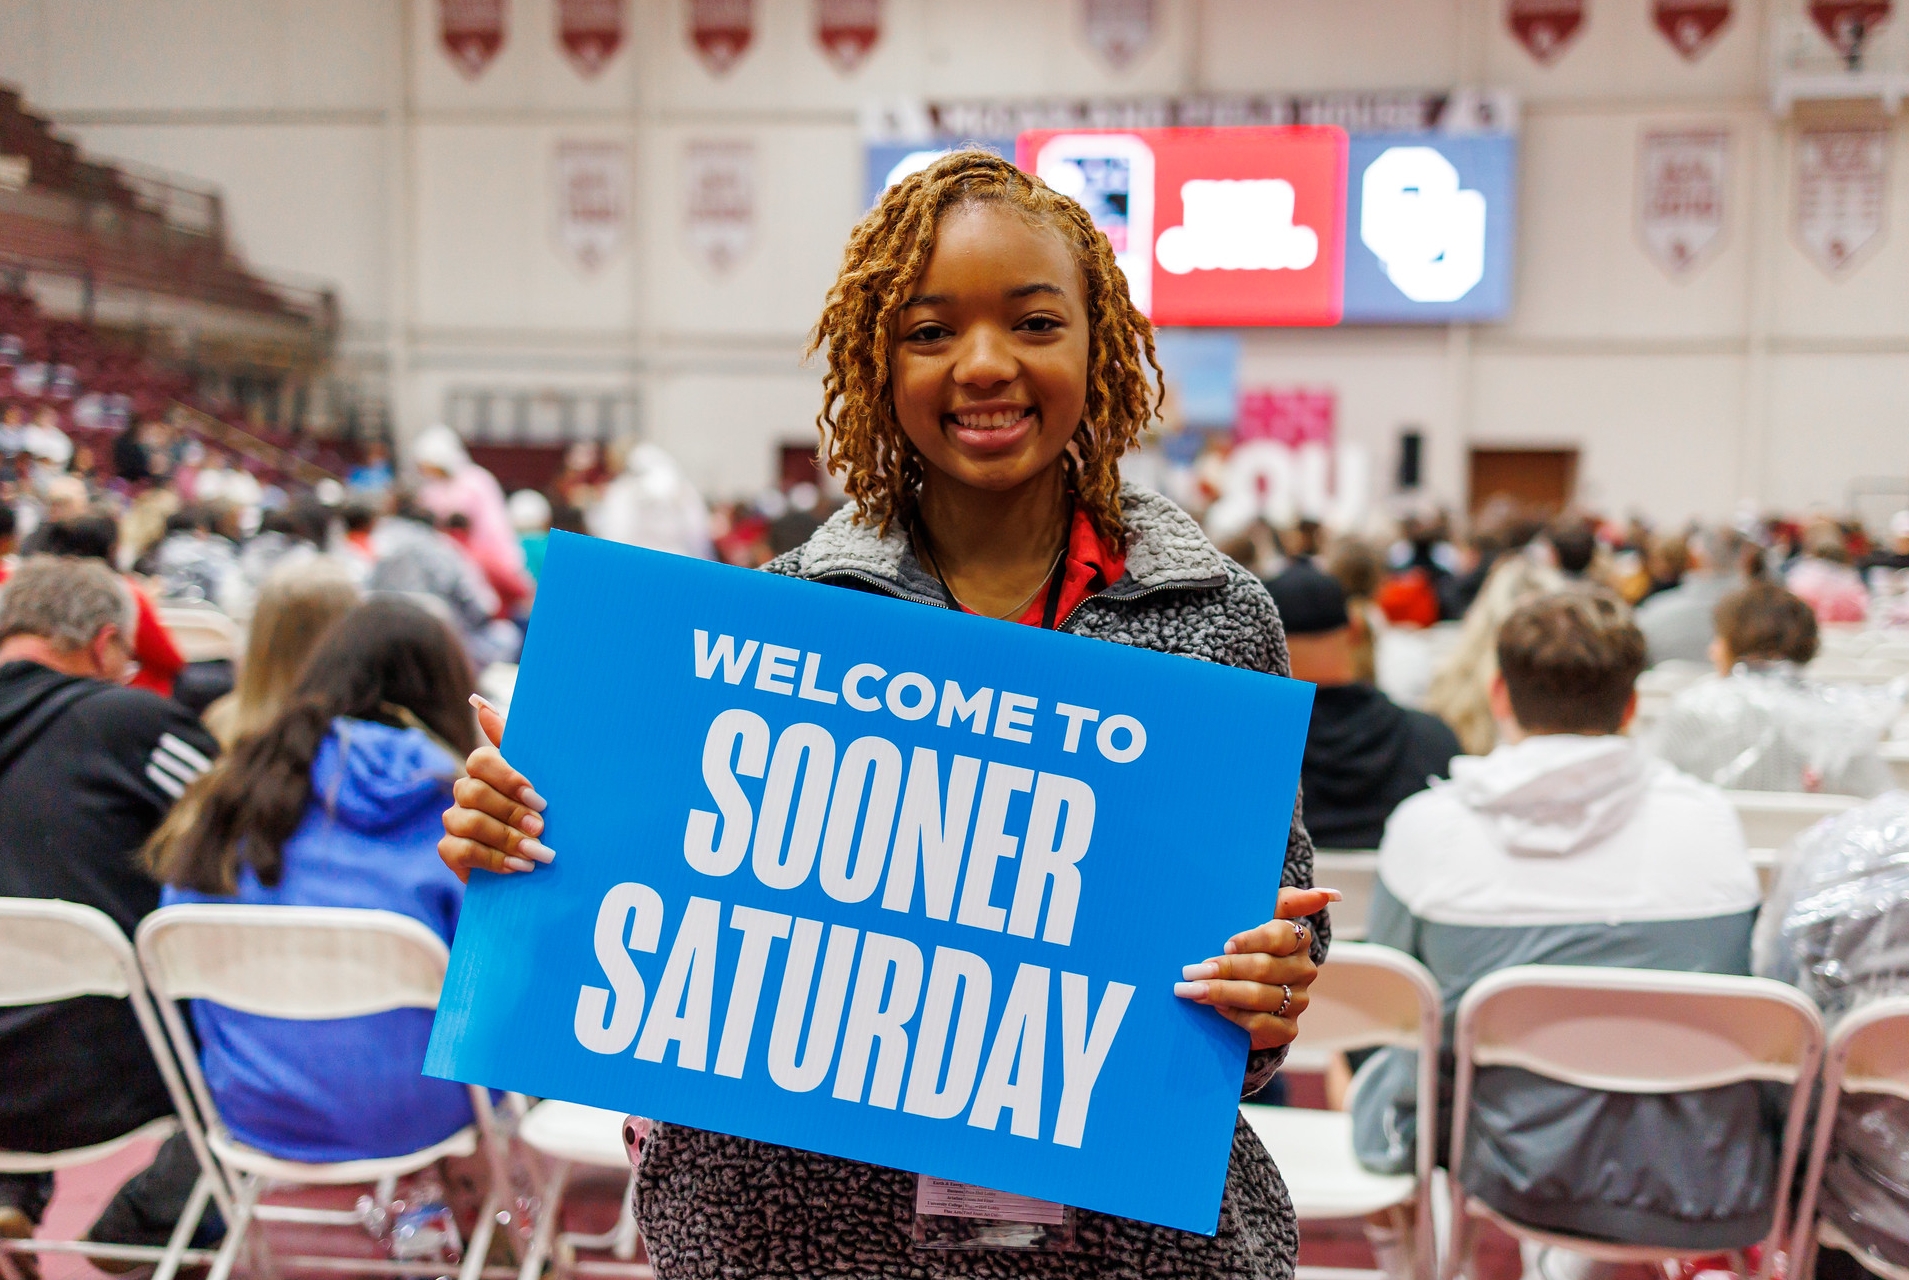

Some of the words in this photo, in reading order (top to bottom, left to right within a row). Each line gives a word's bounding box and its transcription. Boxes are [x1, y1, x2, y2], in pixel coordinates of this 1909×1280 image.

[693, 628, 1039, 744] WELCOME
[1055, 702, 1147, 764] TO
[683, 708, 1096, 947] SOONER
[574, 882, 1136, 1149] SATURDAY
